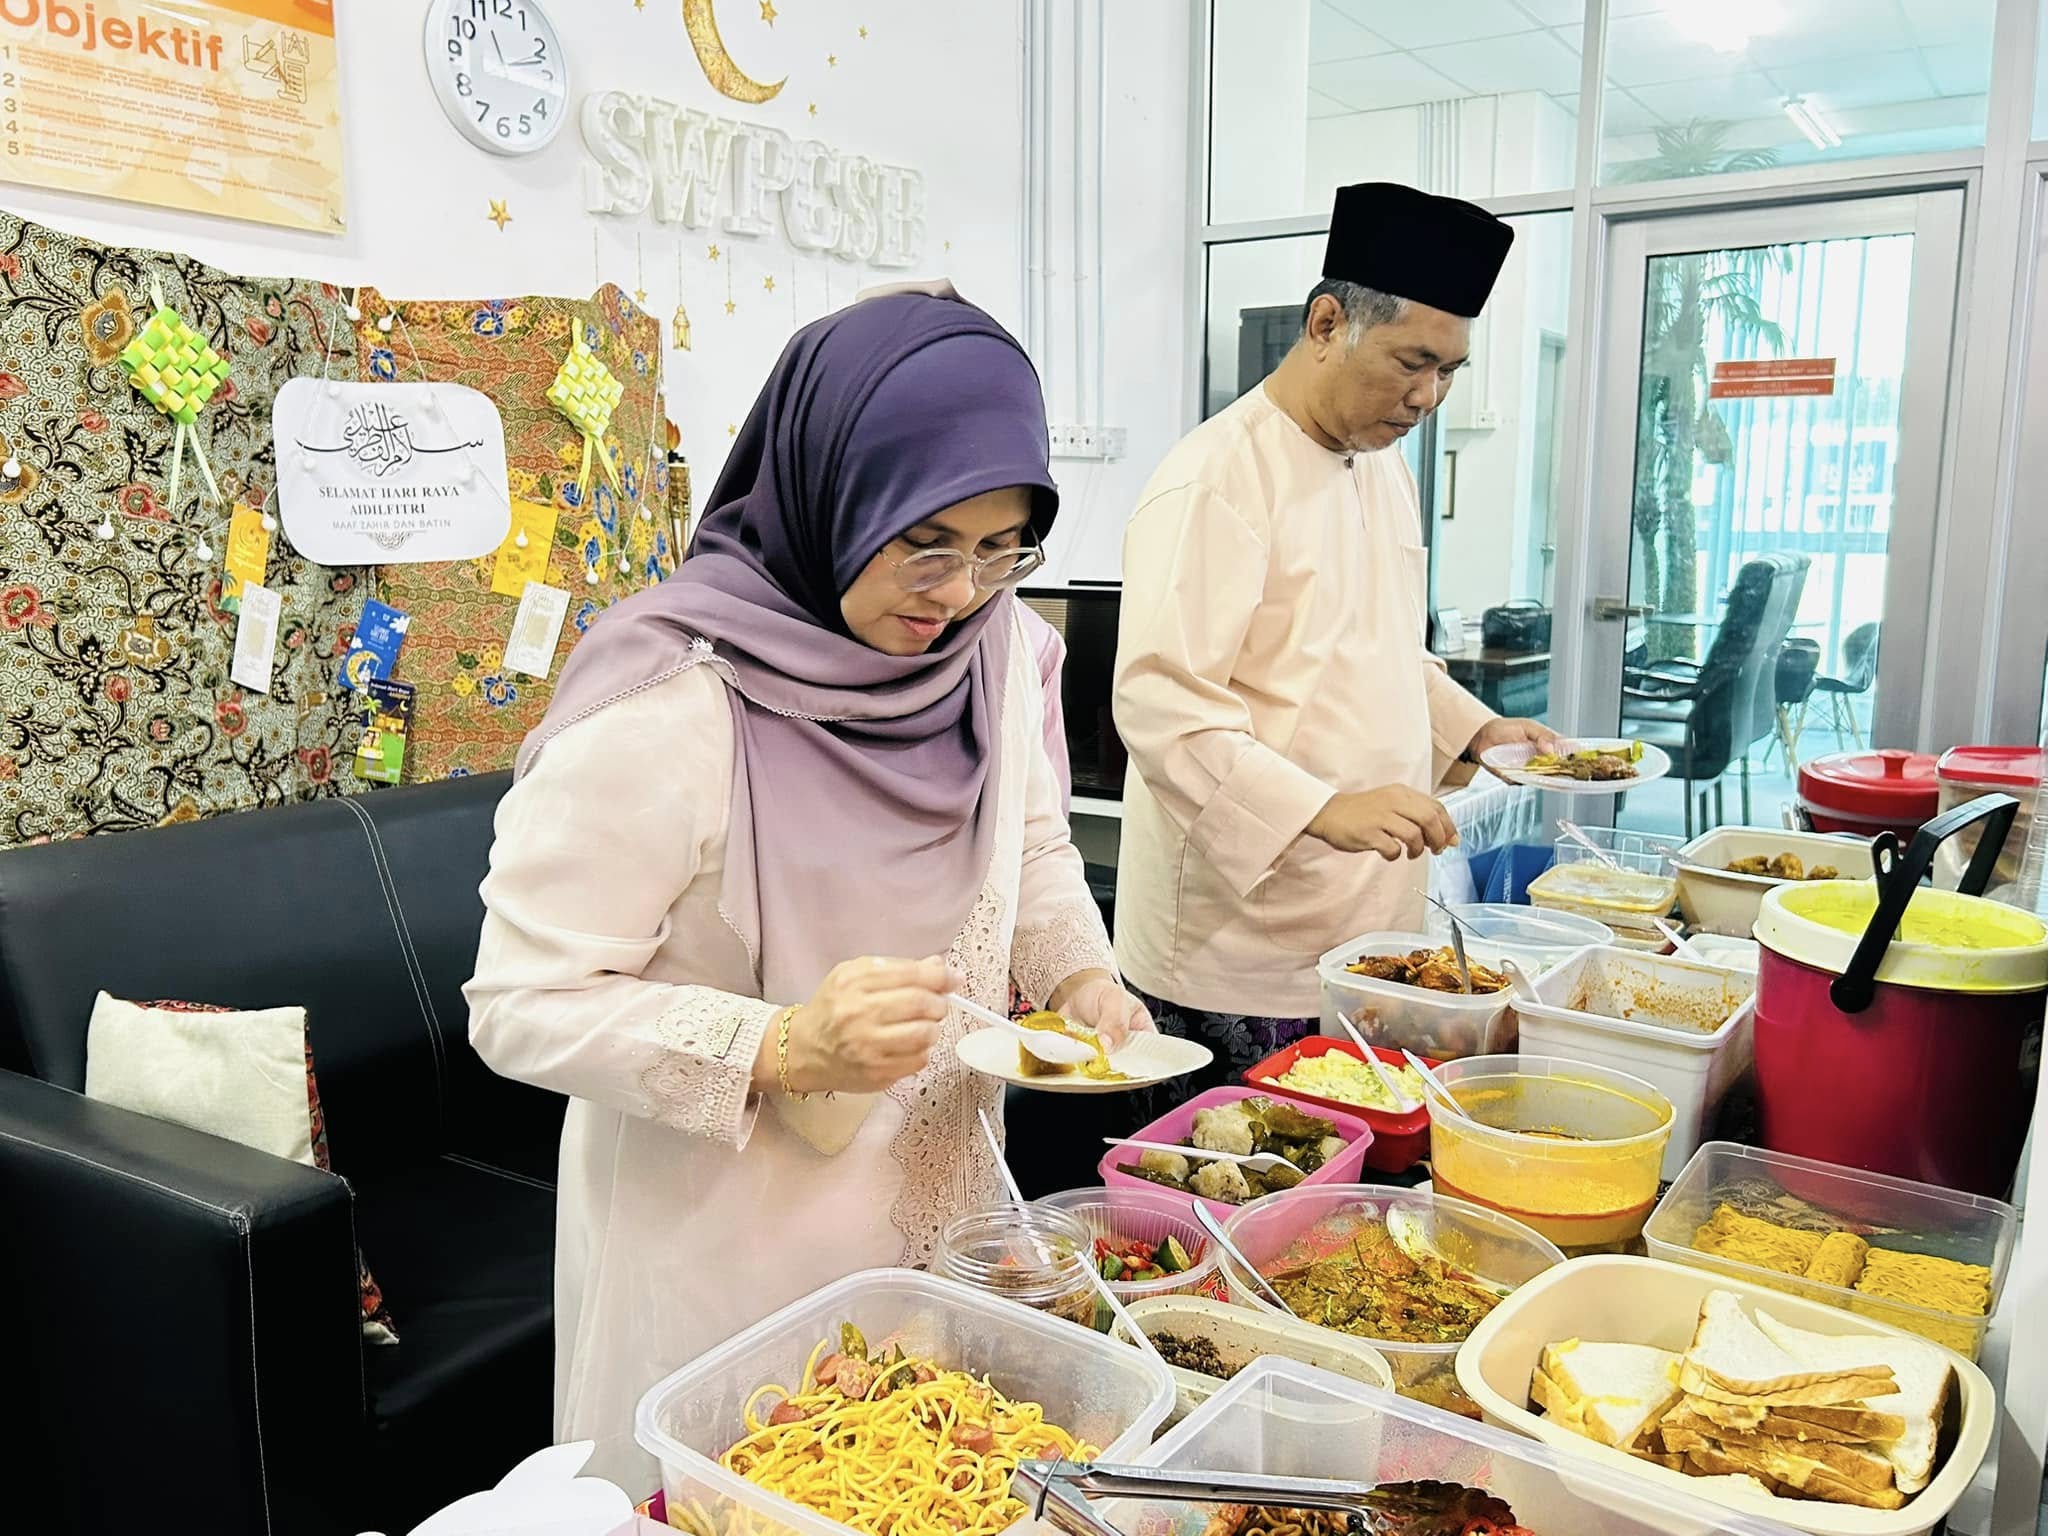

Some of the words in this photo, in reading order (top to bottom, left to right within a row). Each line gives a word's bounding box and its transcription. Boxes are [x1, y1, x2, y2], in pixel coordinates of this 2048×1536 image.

[452, 15, 476, 40] 10
[518, 10, 526, 31] 1
[0, 0, 223, 71] Objektif
[448, 39, 462, 61] 9
[534, 37, 546, 60] 2
[3, 72, 15, 88] 2
[456, 72, 472, 97] 8
[4, 98, 17, 113] 3
[475, 100, 490, 123] 7
[532, 98, 548, 120] 4
[6, 120, 18, 134] 4
[496, 116, 511, 138] 6
[518, 114, 531, 135] 5
[8, 141, 19, 155] 5
[319, 487, 376, 499] SELAMAT
[381, 487, 417, 498] HARI
[422, 485, 460, 497] RAYA
[350, 503, 425, 515] AIDILFITRI
[361, 520, 390, 530] ZAHIR
[393, 520, 415, 529] DAN
[419, 519, 451, 529] BATIN
